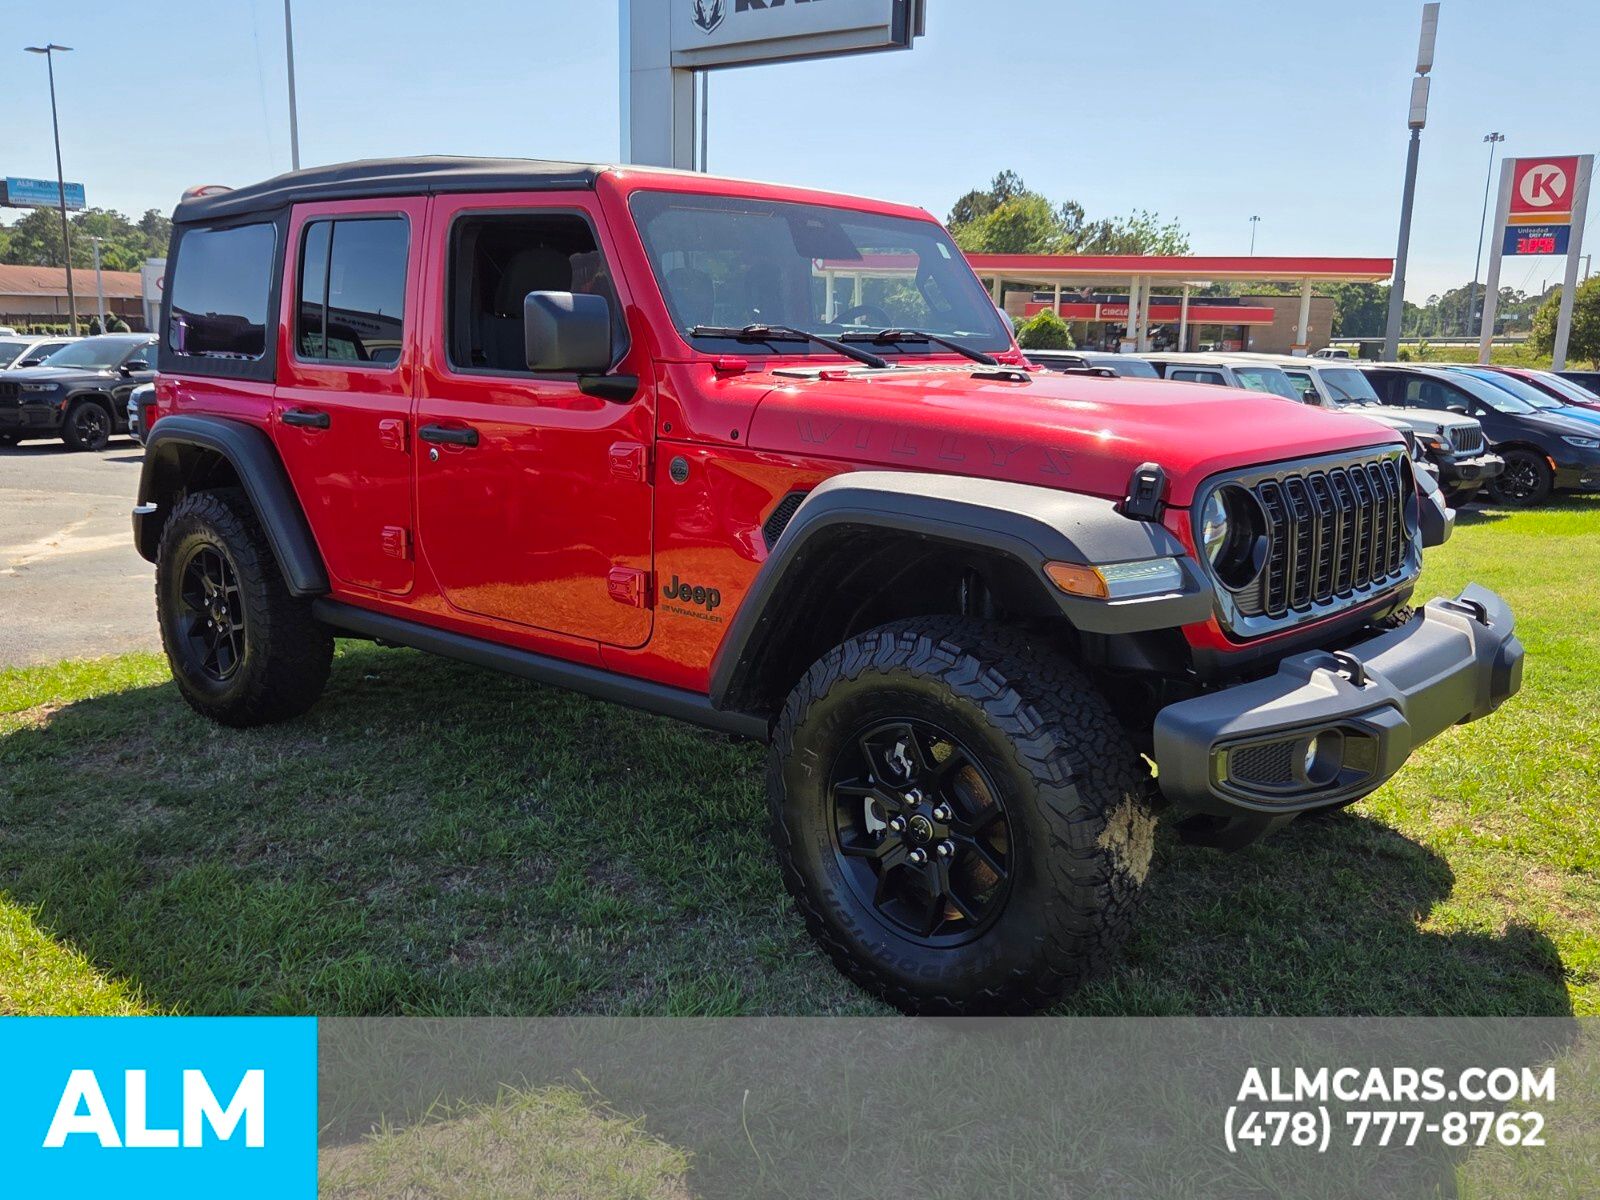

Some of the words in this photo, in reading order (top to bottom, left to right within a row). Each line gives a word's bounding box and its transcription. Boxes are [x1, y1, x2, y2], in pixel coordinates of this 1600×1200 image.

[1532, 172, 1560, 203] K
[1102, 308, 1129, 316] CIRCLE
[796, 418, 1073, 476] WILLYS
[662, 575, 721, 611] Jeep
[670, 605, 723, 623] WRANGLER
